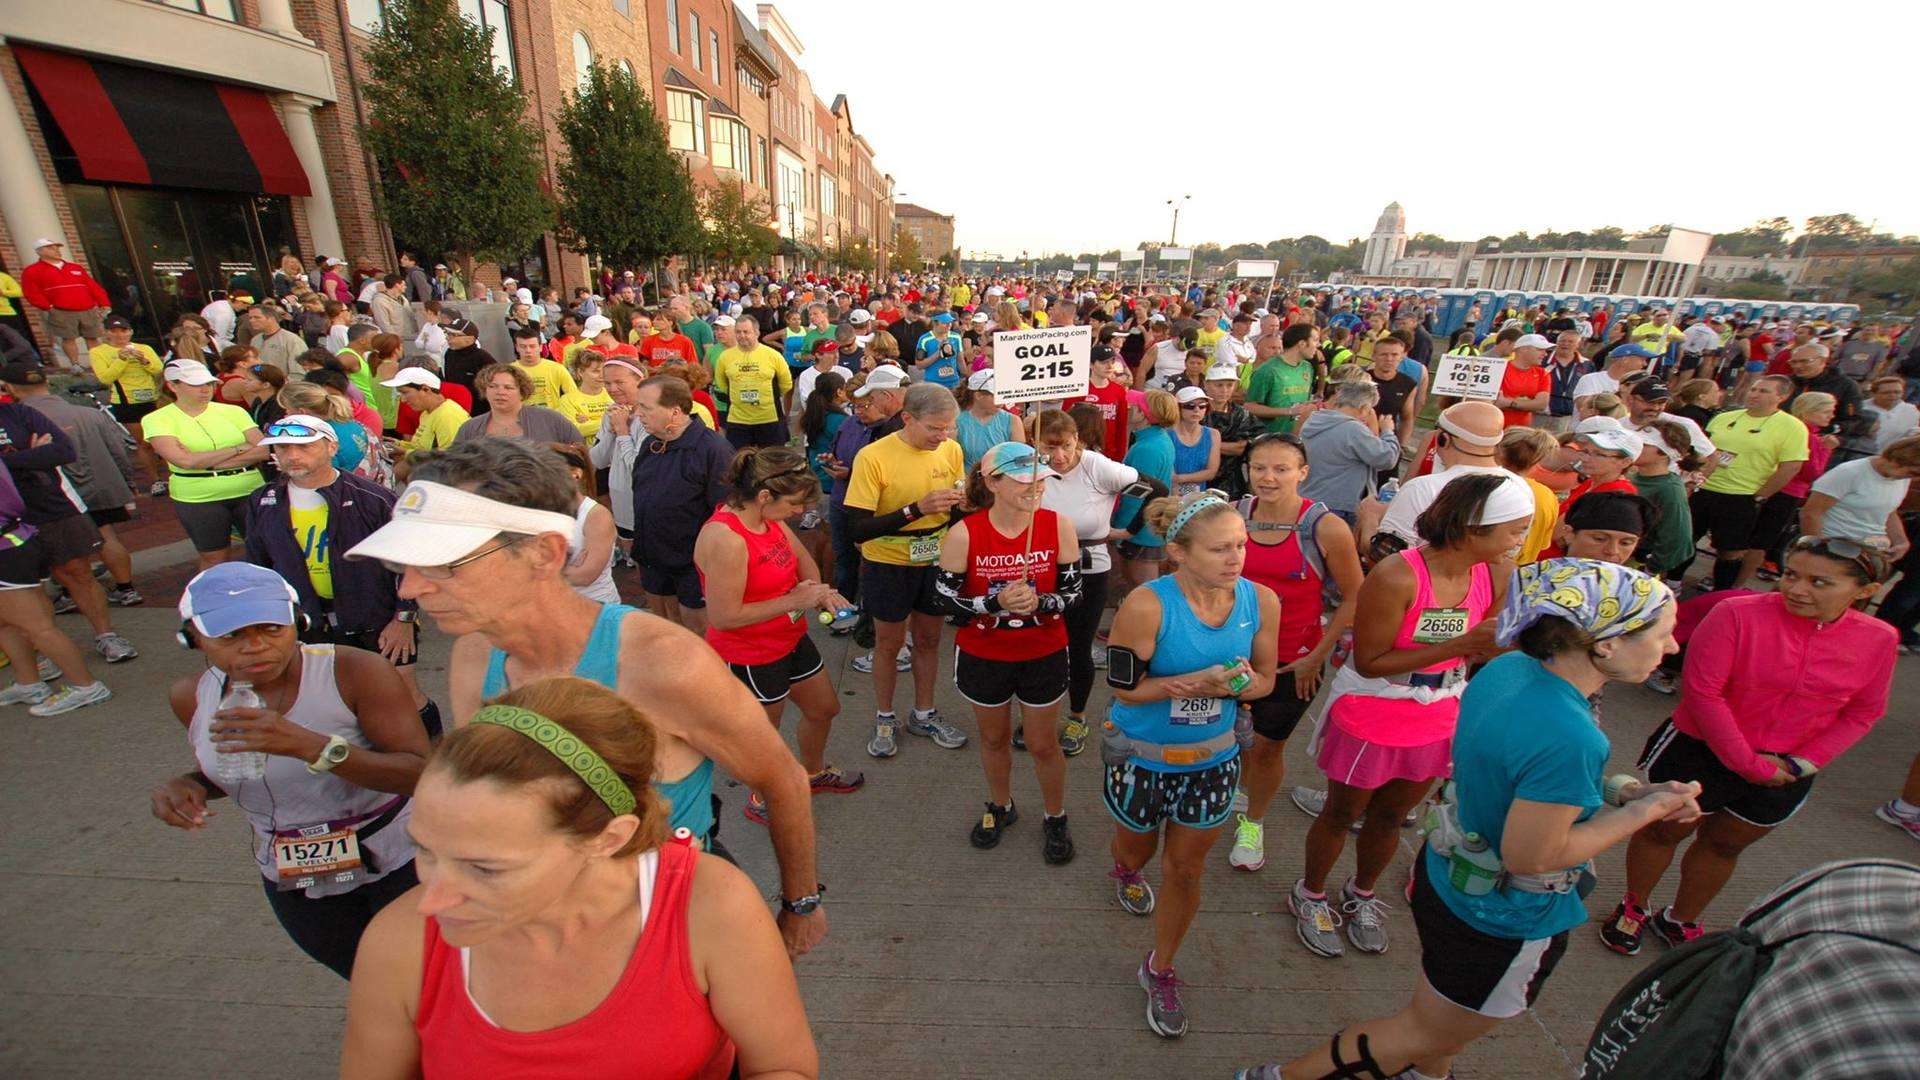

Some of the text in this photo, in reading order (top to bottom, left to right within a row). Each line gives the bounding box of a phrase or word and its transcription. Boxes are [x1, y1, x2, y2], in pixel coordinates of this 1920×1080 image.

[1000, 329, 1088, 342] MarathonPacing.com
[1015, 343, 1069, 359] GOAL
[1021, 360, 1074, 381] 2:15
[1453, 363, 1491, 373] PACE
[1449, 372, 1490, 384] 1018
[912, 542, 939, 555] 26505
[1421, 618, 1464, 632] 26568
[281, 838, 348, 861] 15271
[297, 856, 338, 866] EVELYN
